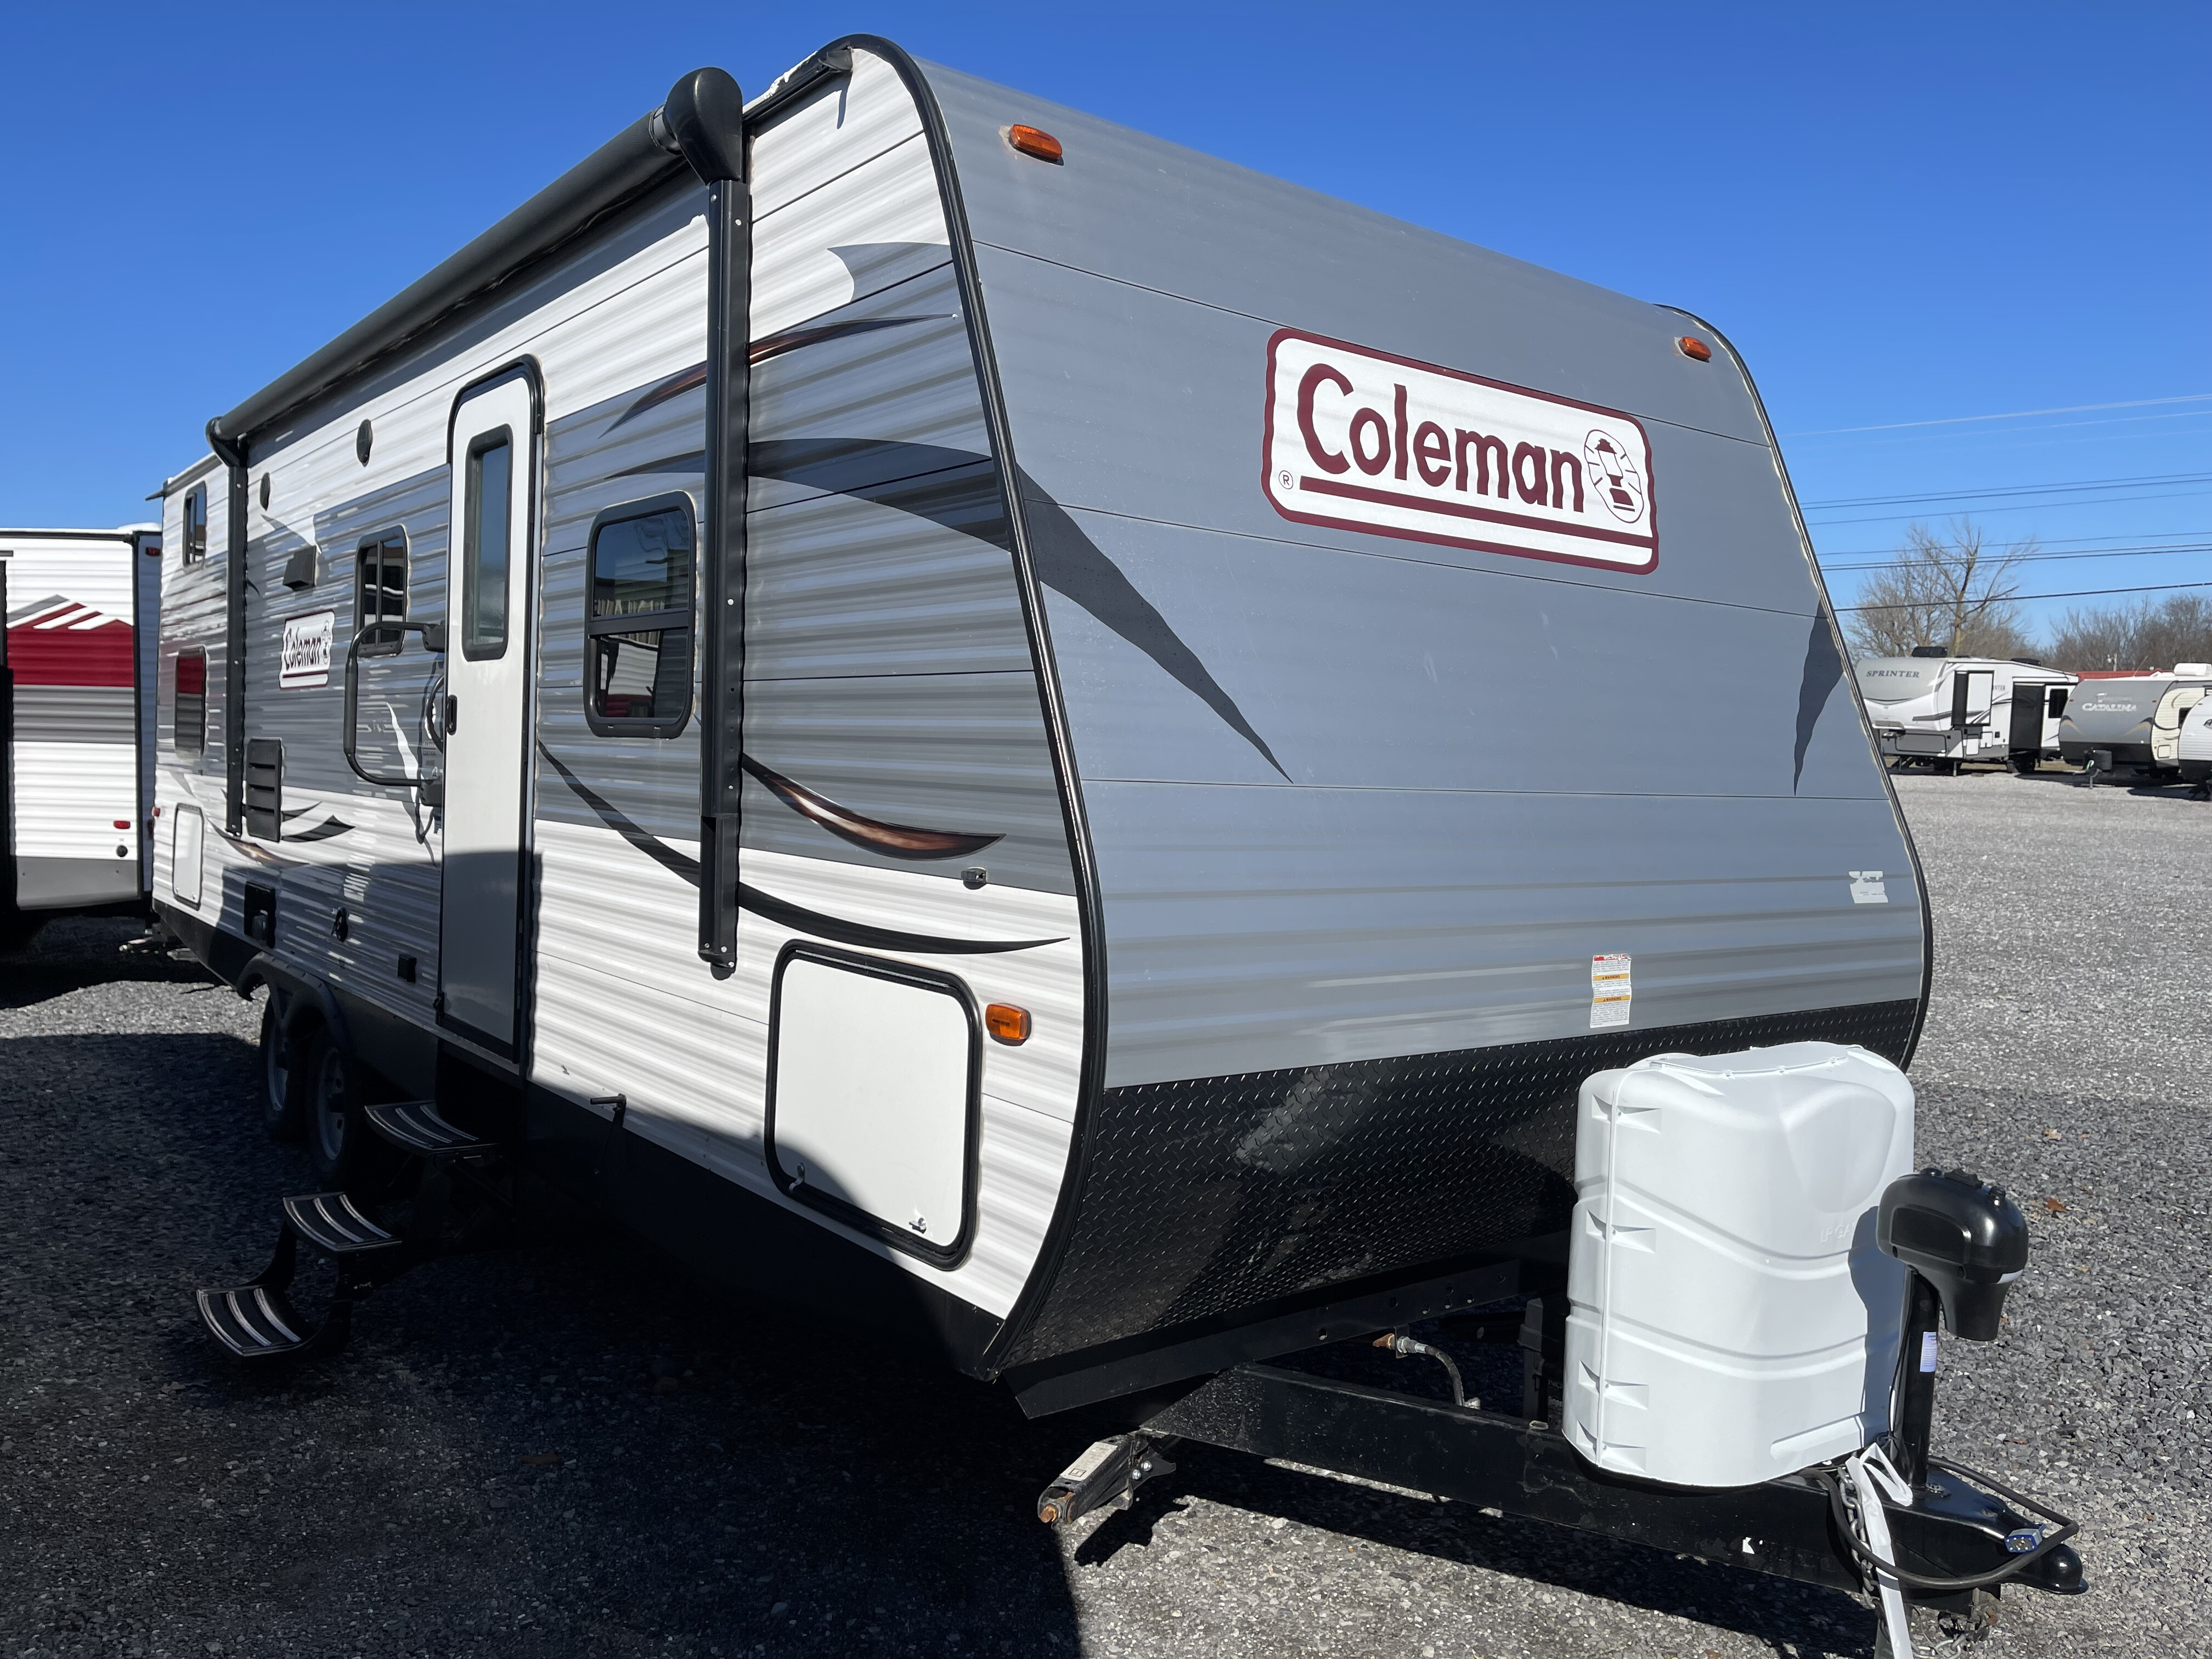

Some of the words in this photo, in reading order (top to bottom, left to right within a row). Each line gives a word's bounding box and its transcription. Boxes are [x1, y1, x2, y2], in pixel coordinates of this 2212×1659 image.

[1296, 363, 1584, 513] Coleman
[284, 627, 321, 671] Coleman
[1866, 670, 1920, 678] SPRINTER
[2081, 702, 2137, 712] CATALINA
